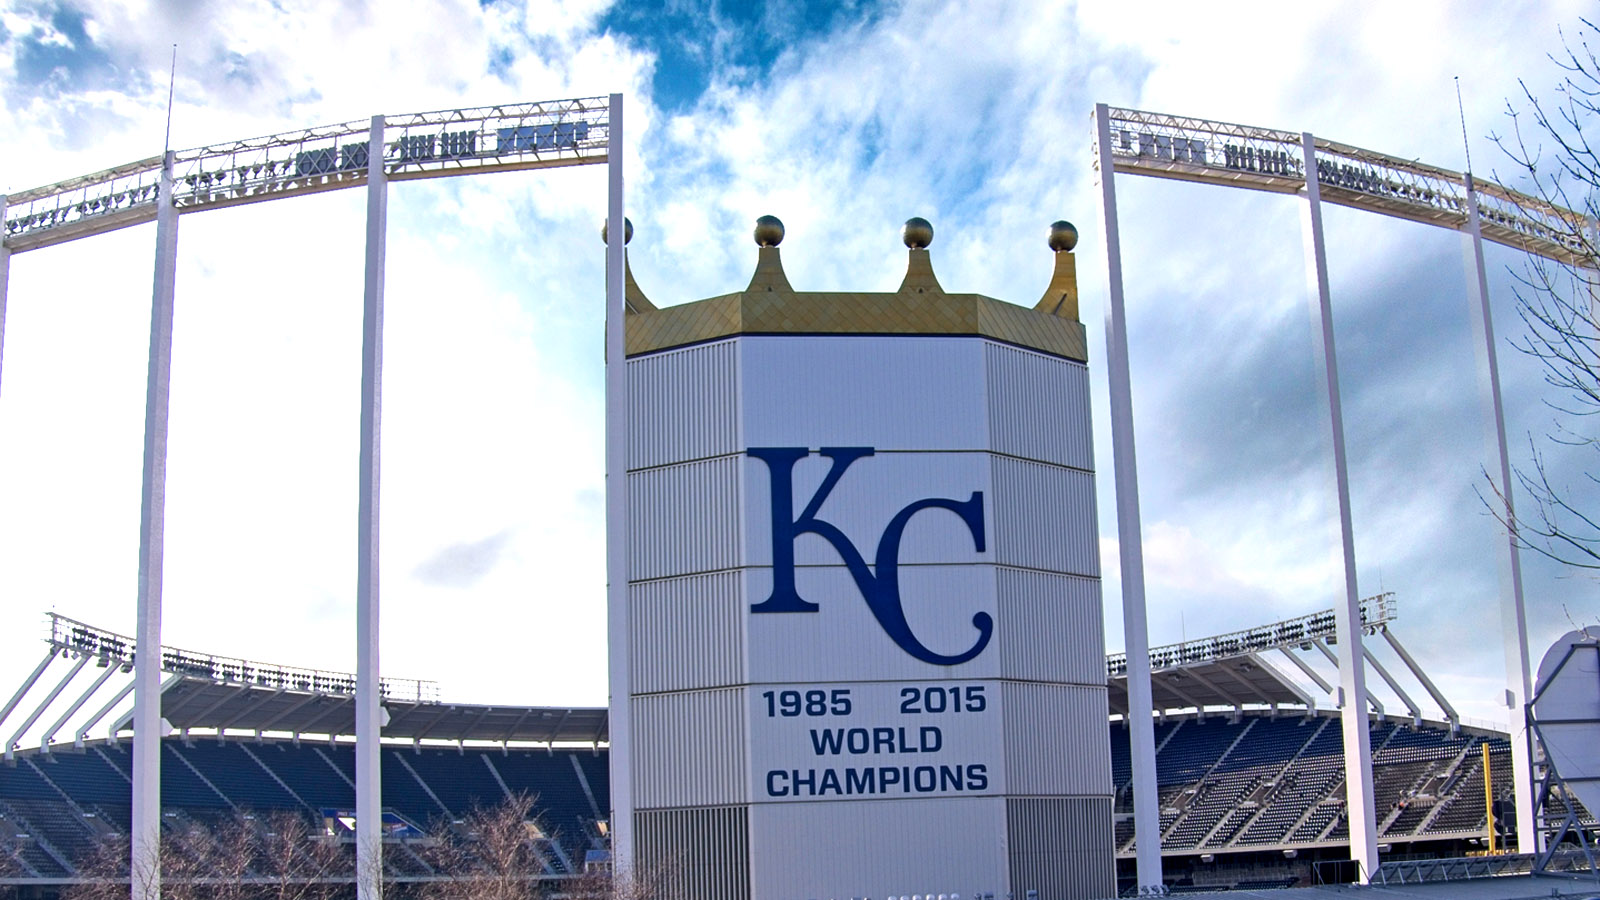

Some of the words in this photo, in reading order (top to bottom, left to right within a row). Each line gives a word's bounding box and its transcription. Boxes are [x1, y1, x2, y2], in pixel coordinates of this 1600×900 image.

[747, 447, 993, 666] KC
[763, 689, 852, 717] 1985
[900, 686, 987, 714] 2015
[810, 726, 943, 756] WORLD
[766, 764, 989, 797] CHAMPIONS
